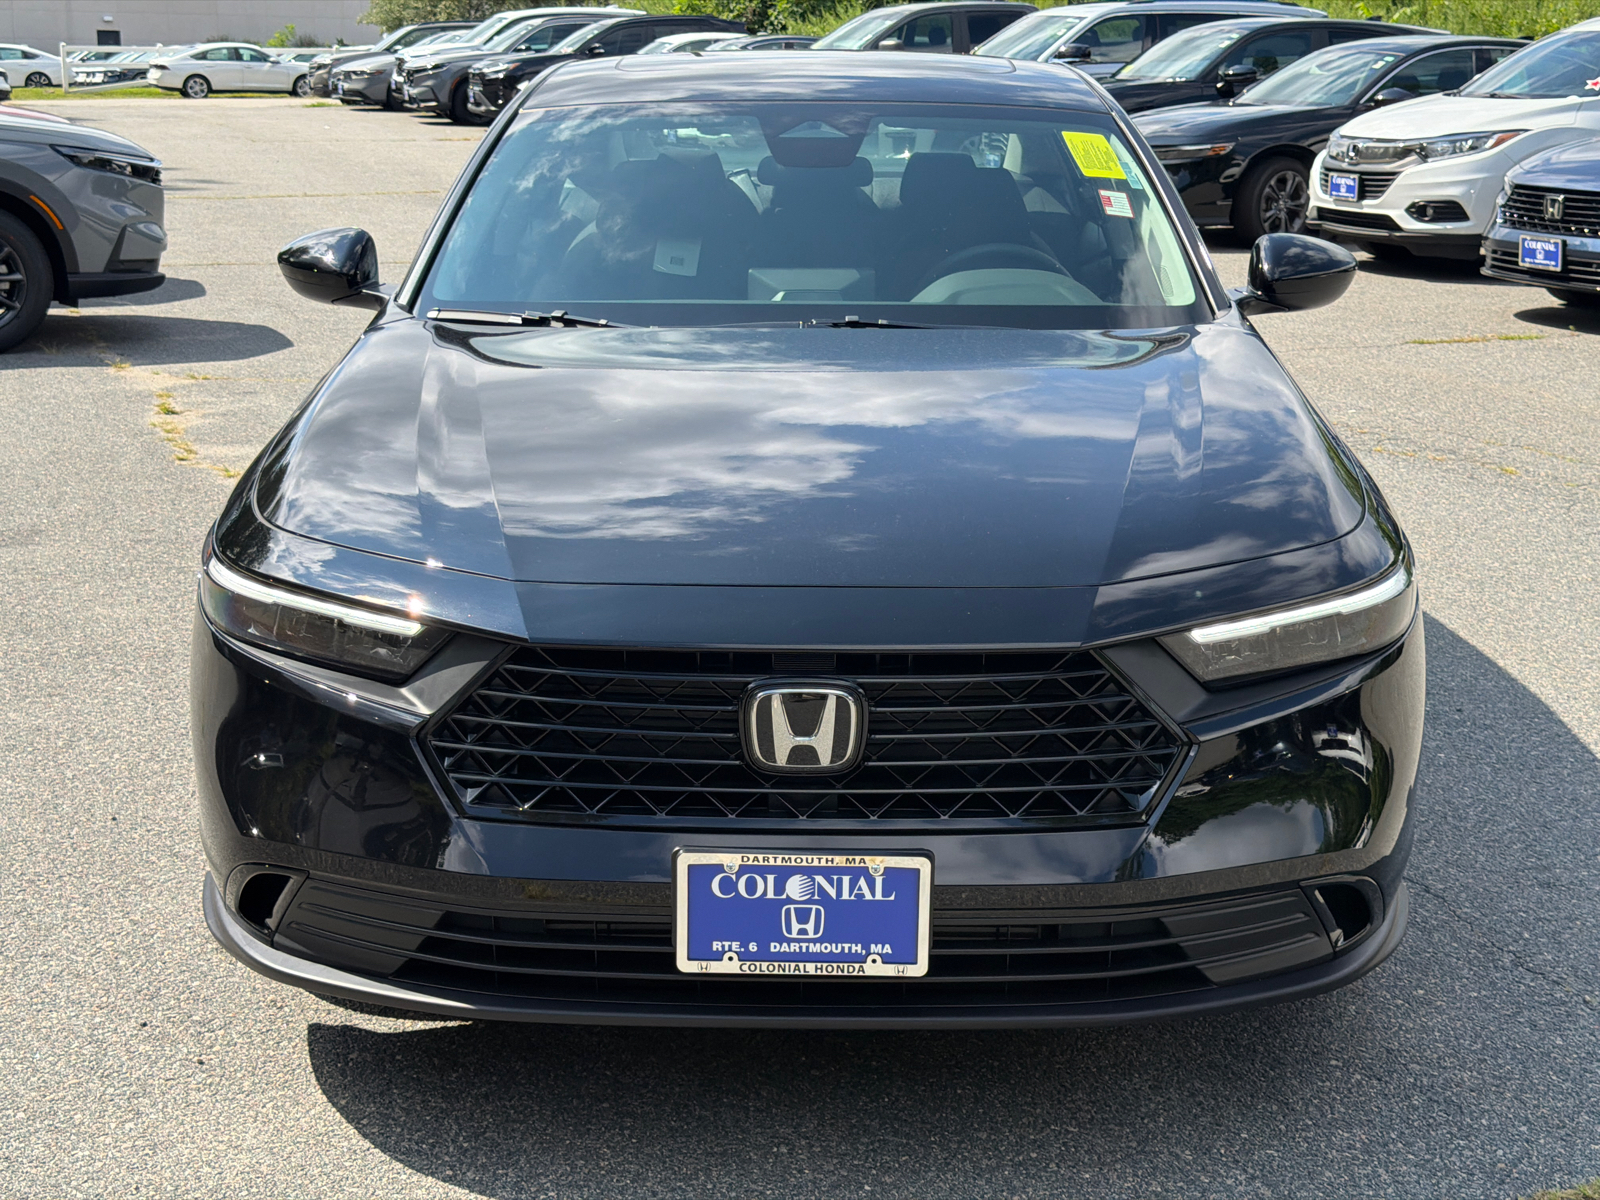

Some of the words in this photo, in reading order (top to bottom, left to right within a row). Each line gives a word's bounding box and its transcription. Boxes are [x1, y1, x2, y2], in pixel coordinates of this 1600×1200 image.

[740, 855, 839, 865] DARTMOUTH,
[845, 857, 867, 865] MA
[711, 872, 896, 901] COLONIAL
[712, 941, 744, 952] RTE.
[748, 942, 758, 952] 6
[770, 942, 866, 955] DARTMOUTH,
[870, 944, 892, 954] MA
[739, 963, 810, 973] COLONIAL
[814, 964, 865, 974] HONDA
